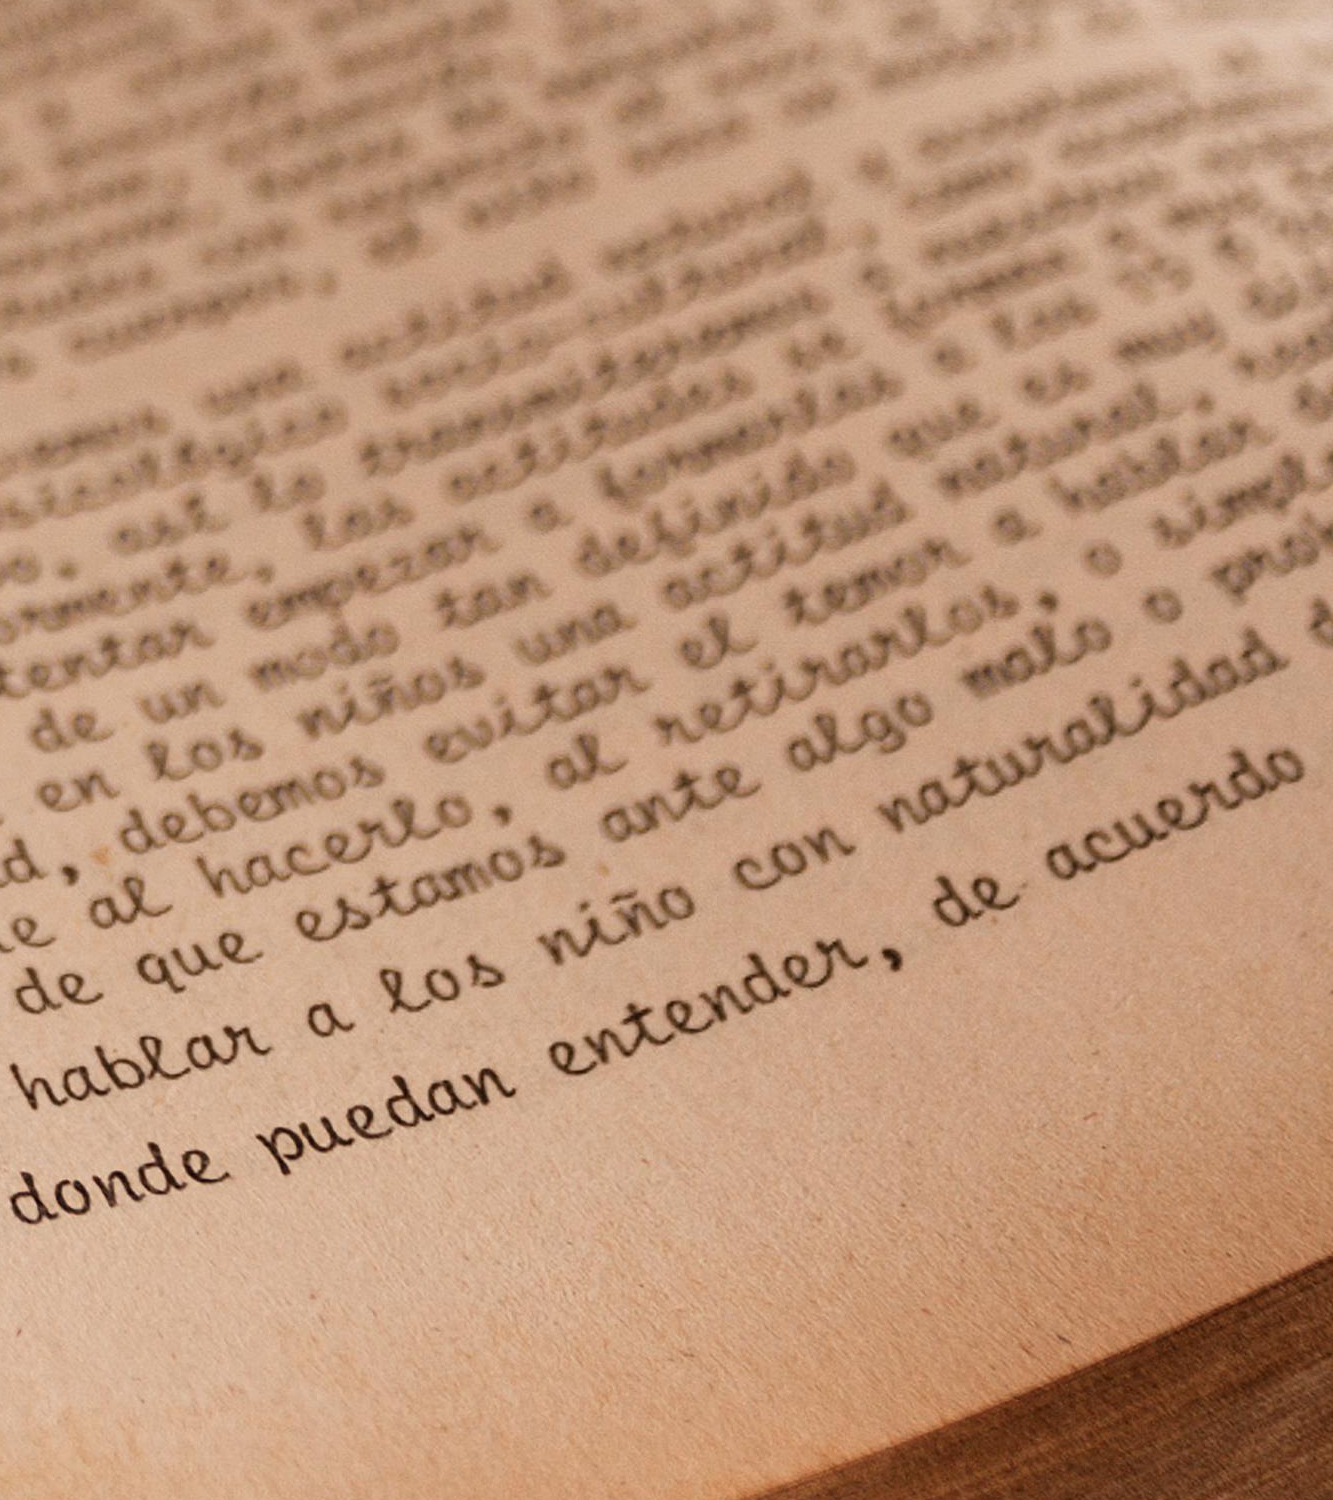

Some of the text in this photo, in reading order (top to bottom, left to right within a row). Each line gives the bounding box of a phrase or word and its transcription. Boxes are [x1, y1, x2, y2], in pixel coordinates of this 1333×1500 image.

[29, 709, 112, 753] de
[140, 682, 223, 725] un
[248, 626, 398, 692] modo
[435, 574, 548, 629] tan
[36, 771, 119, 813] en
[144, 729, 264, 782] los
[297, 657, 485, 740] niños
[516, 604, 634, 665] una
[662, 482, 909, 610] actitud
[88, 875, 173, 931] al
[194, 796, 513, 899] hacerlo,
[546, 734, 626, 791] al
[1083, 544, 1122, 578] o
[117, 757, 385, 854] debemos
[423, 667, 649, 765] evitar
[678, 616, 755, 671] el
[783, 540, 969, 626] temor
[992, 510, 1040, 545] a
[245, 527, 495, 630] empezar
[8, 1025, 274, 1112] hablar
[305, 1002, 356, 1040] a
[378, 954, 507, 1015] los
[536, 886, 697, 968] niño
[731, 827, 857, 893] con
[875, 628, 1290, 835] naturalidad
[13, 967, 104, 1016] de
[134, 931, 264, 995] que
[293, 834, 567, 944] estamos
[600, 766, 762, 844] ante
[785, 694, 933, 774] algo
[960, 620, 1113, 699] malo
[1142, 589, 1183, 625] o
[8, 1142, 233, 1227] donde
[255, 1067, 518, 1178] puedan
[547, 939, 905, 1078] entender,
[931, 875, 1020, 930] de
[1044, 748, 1306, 883] acuerdo
